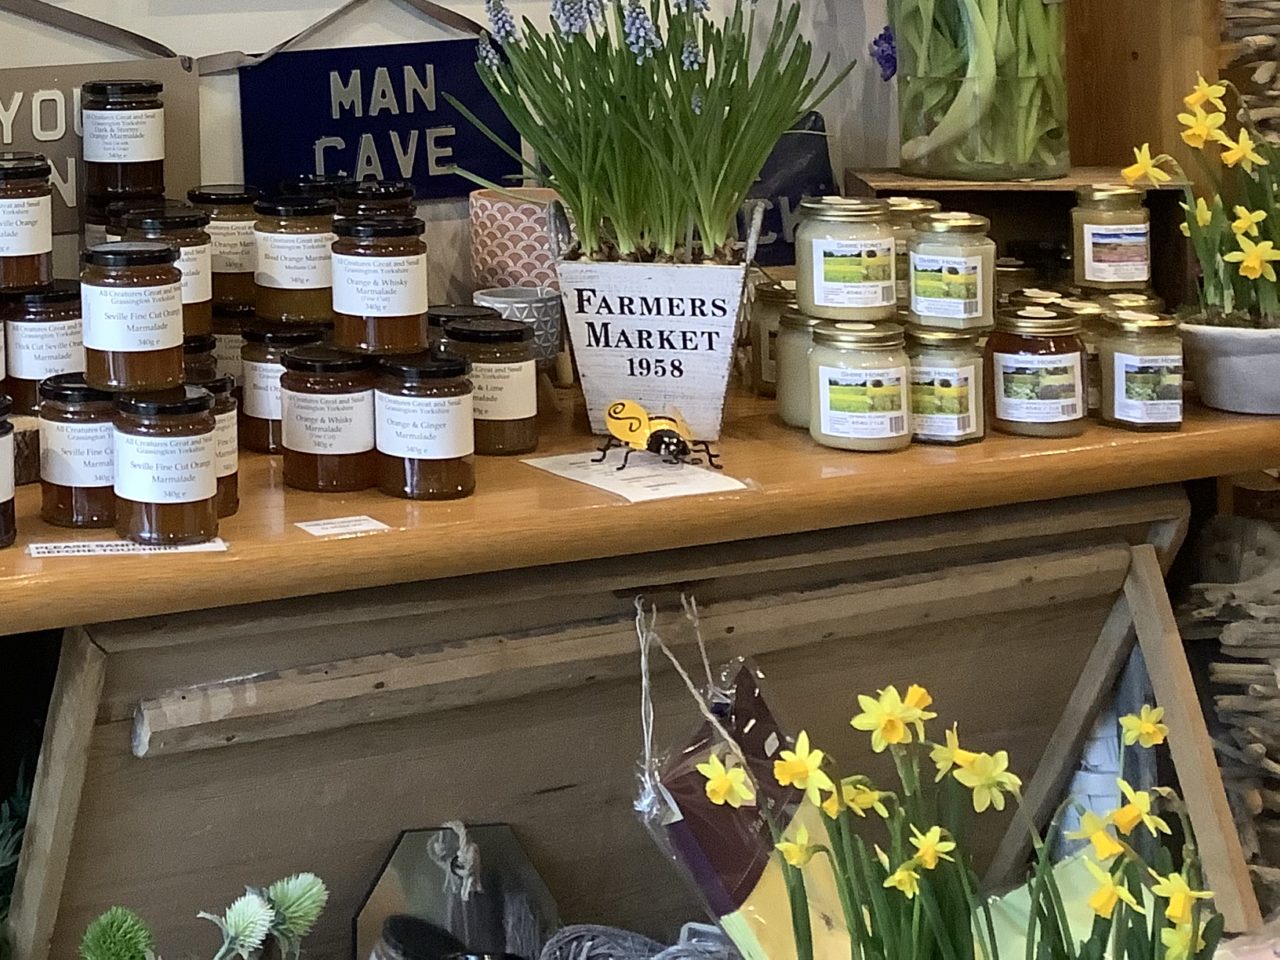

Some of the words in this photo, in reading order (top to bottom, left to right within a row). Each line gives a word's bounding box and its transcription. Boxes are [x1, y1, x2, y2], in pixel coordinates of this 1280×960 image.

[330, 64, 436, 119] MAN
[314, 127, 456, 180] CAVE
[347, 279, 371, 287] Orange
[382, 278, 408, 287] Whisky
[574, 288, 727, 317] FARMERS
[105, 313, 128, 321] Seville
[131, 312, 147, 320] Fine
[149, 311, 162, 319] Cut
[126, 323, 168, 333] Marmalade
[586, 322, 720, 350] MARKET
[627, 358, 684, 378] 1958
[395, 432, 437, 440] Marmalade
